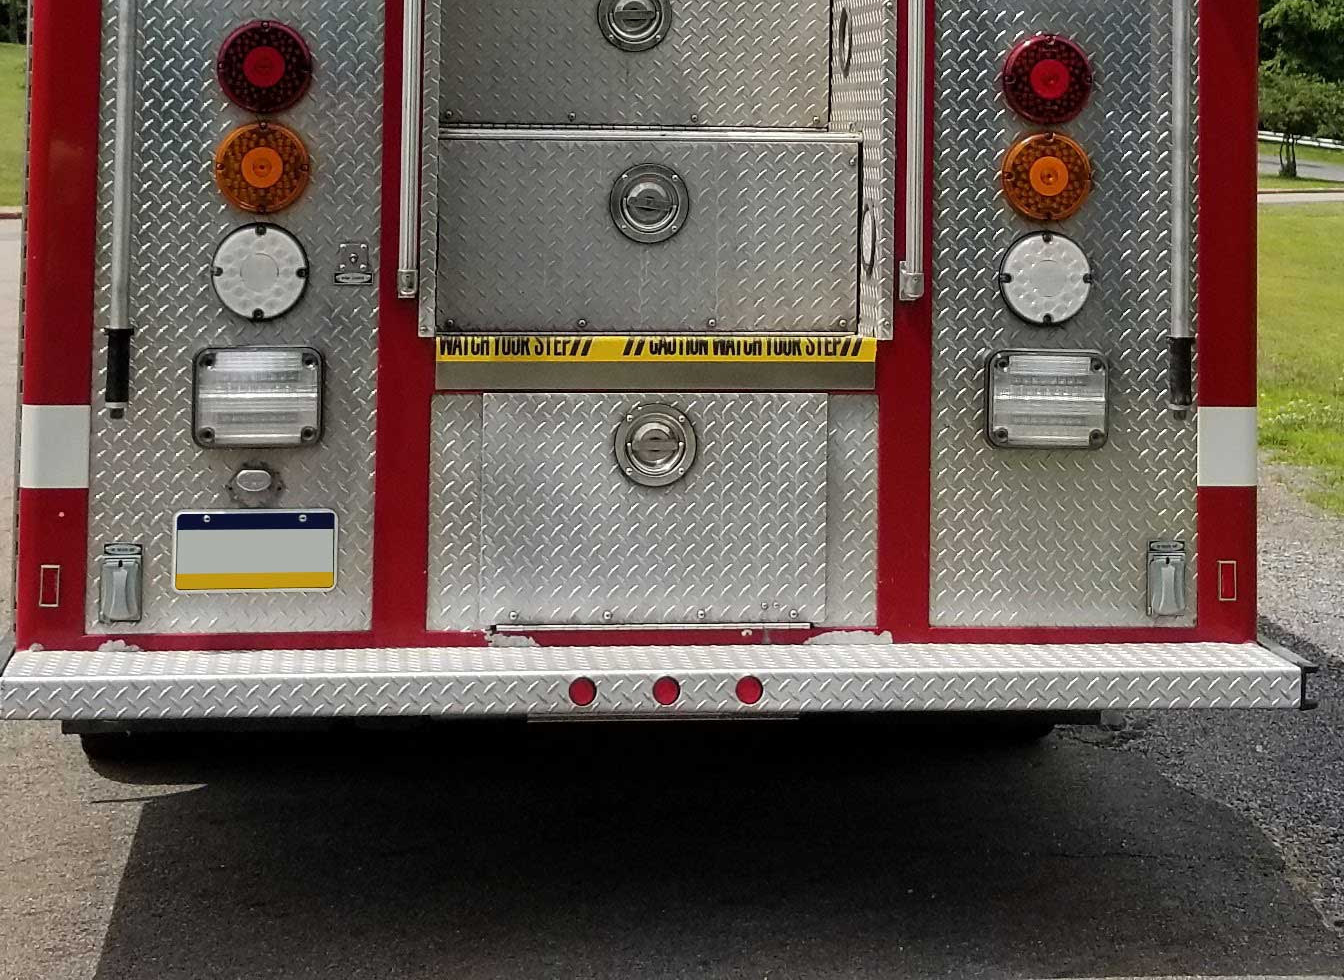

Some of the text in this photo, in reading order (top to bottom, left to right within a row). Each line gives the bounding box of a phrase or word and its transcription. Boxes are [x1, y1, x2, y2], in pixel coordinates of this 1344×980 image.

[439, 336, 571, 357] WATCH YOUR STEP
[649, 338, 842, 357] CAUTION WATCH YOUR STEP
